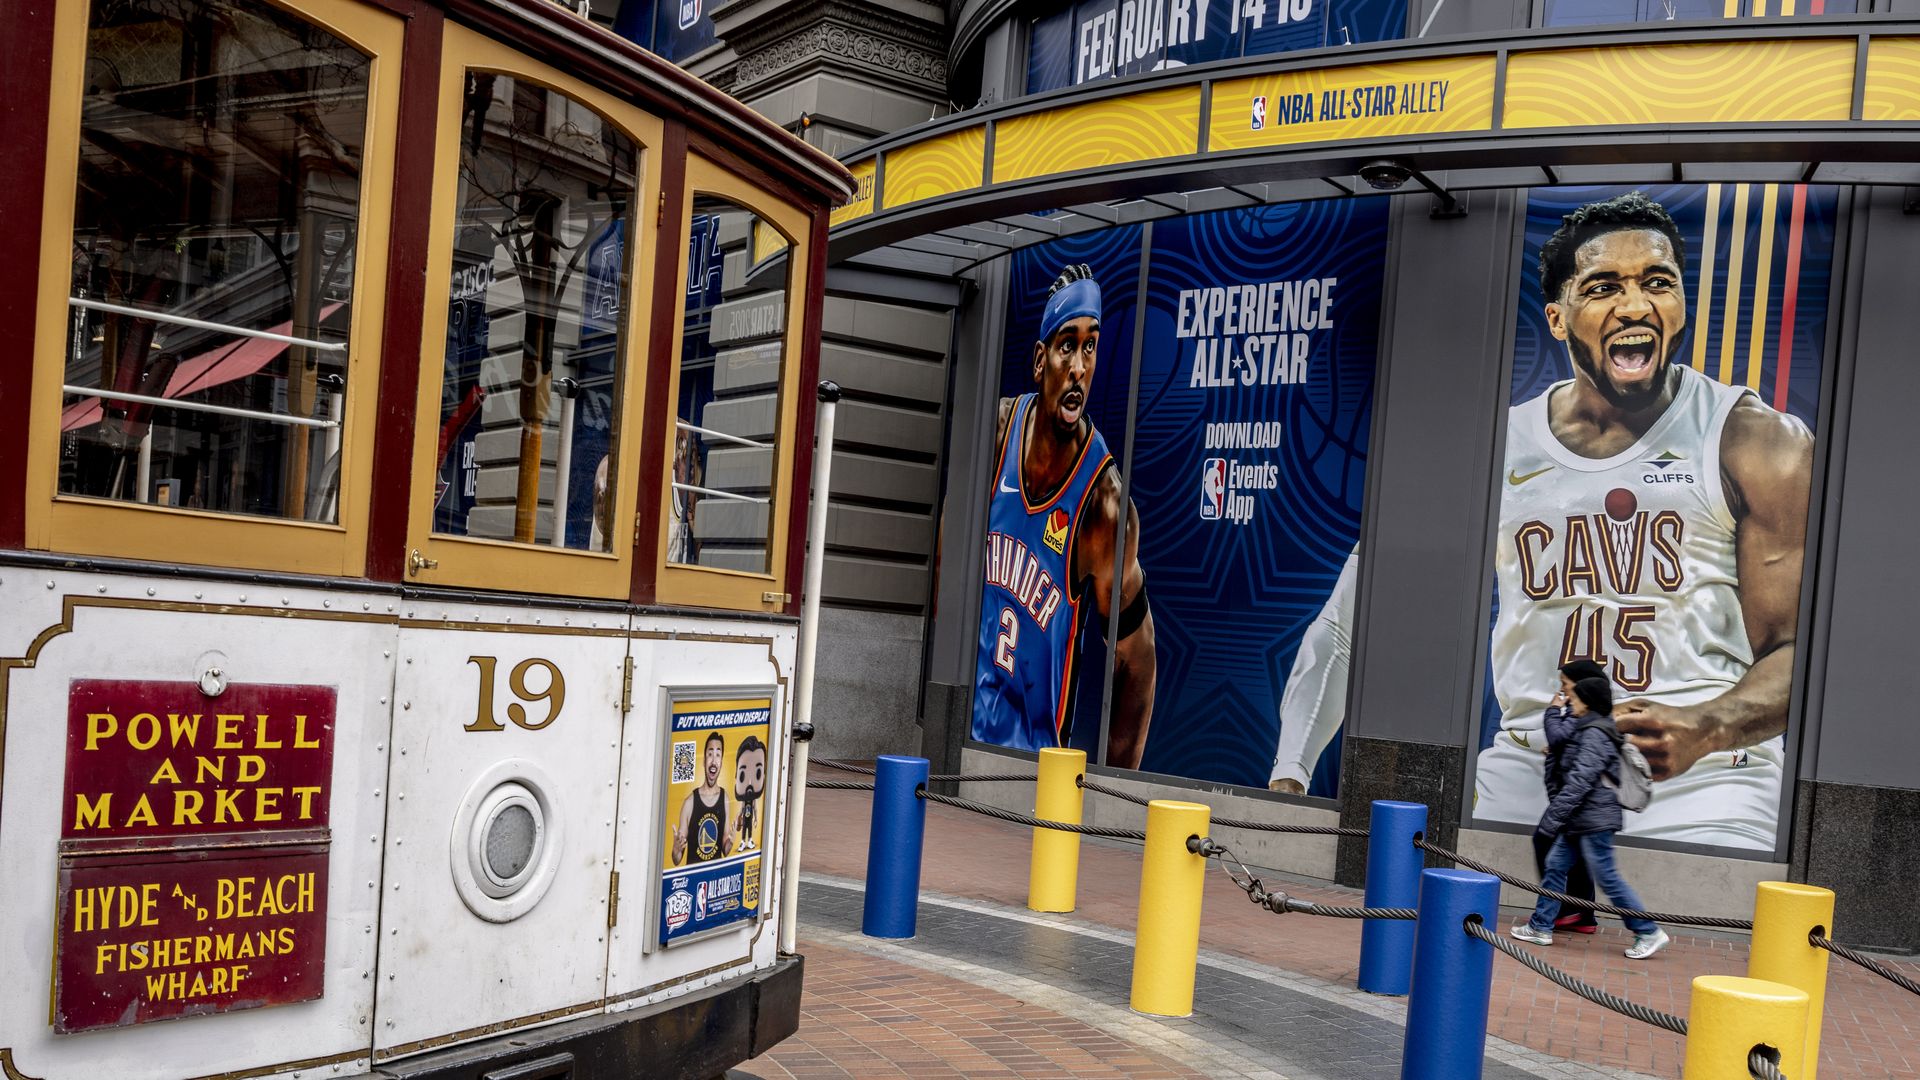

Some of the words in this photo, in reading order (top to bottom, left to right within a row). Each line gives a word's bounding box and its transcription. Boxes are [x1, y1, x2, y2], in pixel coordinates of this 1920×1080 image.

[1077, 0, 1210, 85] FEBRUARY
[1278, 93, 1314, 125] NBA
[1399, 80, 1449, 115] ALLEY
[1176, 277, 1337, 338] EXPERIENCE
[1205, 421, 1281, 449] DOWNLOAD
[1228, 459, 1279, 490] Events
[1643, 473, 1694, 484] CLIFFS
[1225, 489, 1255, 525] App
[1514, 510, 1685, 601] CAVS
[994, 606, 1020, 678] 2
[1558, 603, 1656, 692] 45
[463, 655, 566, 733] 19
[84, 712, 320, 751] POWELL
[676, 716, 694, 728] PUT
[693, 714, 714, 727] YOUR
[714, 713, 735, 726] GAME
[734, 712, 745, 724] ON
[744, 710, 770, 723] DISPLAY
[150, 755, 267, 784] AND
[73, 786, 321, 830] MARKET
[73, 883, 161, 932] HYDE
[171, 882, 209, 922] AND
[216, 872, 316, 920] BEACH
[96, 927, 295, 975] FISHERMANS
[146, 964, 249, 1002] WHARF
